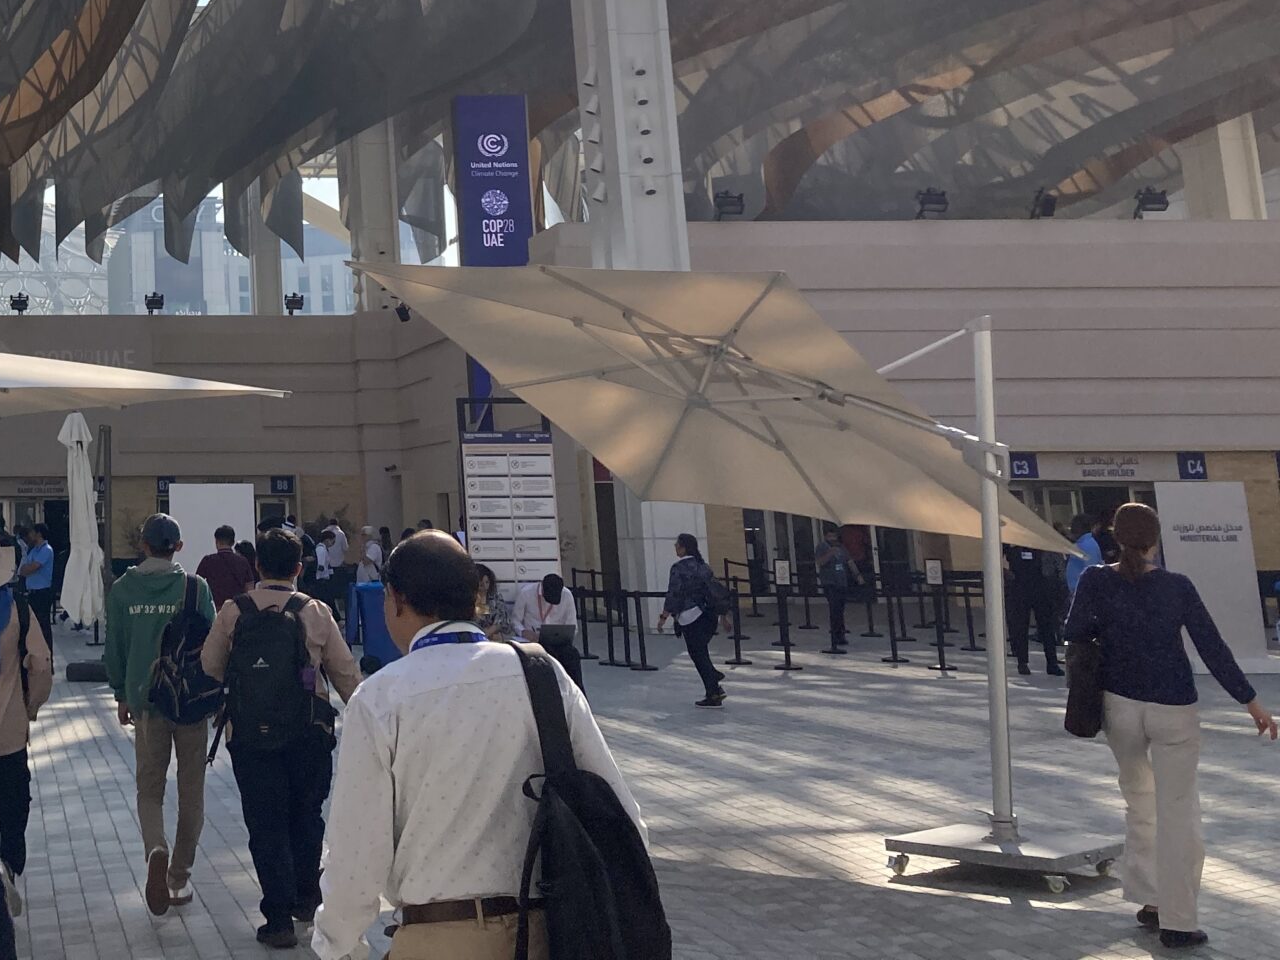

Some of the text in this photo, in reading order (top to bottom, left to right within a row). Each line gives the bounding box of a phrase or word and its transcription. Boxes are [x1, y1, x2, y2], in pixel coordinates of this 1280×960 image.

[495, 170, 519, 178] Change
[482, 219, 515, 233] COP28
[482, 233, 505, 247] UAE
[1013, 460, 1029, 475] C3
[1187, 459, 1204, 474] C4
